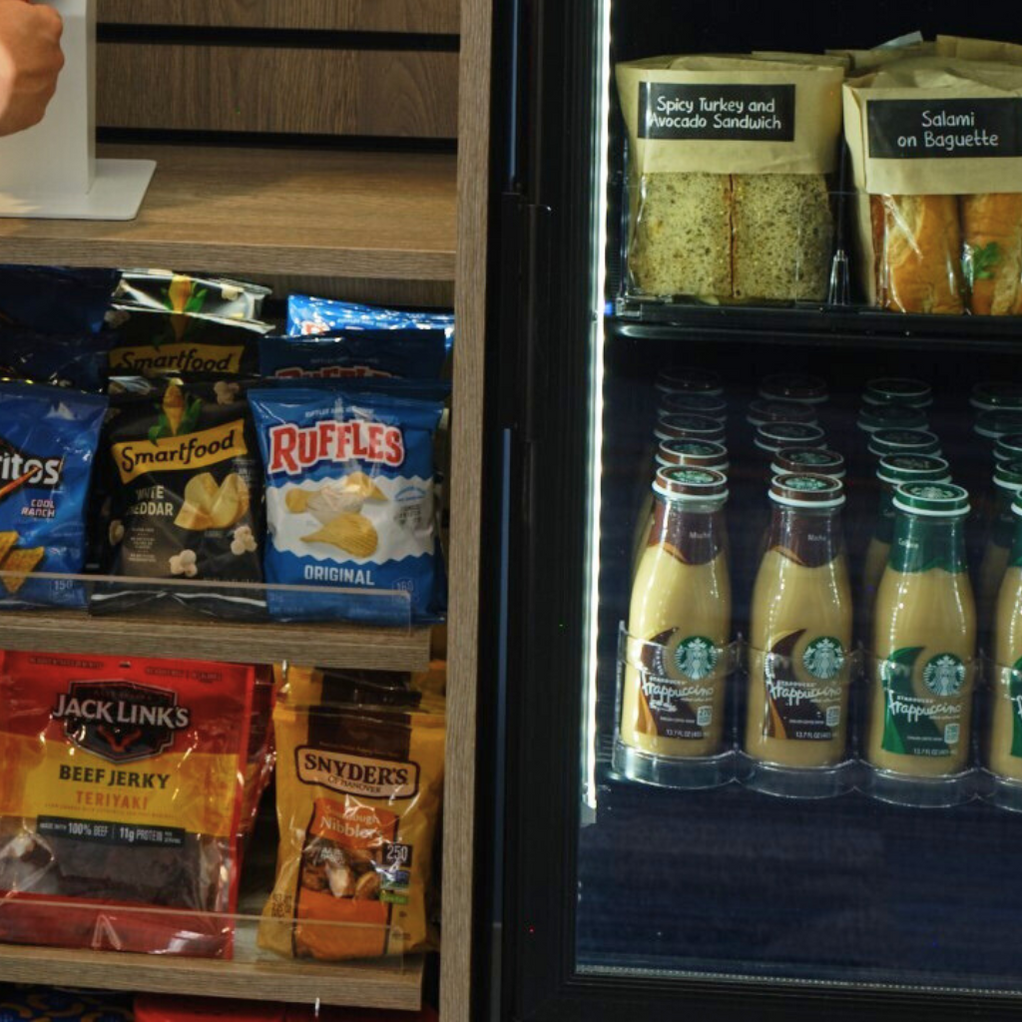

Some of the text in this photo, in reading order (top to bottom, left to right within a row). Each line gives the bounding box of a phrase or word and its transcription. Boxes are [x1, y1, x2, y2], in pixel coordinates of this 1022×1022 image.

[657, 96, 775, 115] Spicy Turkey and
[649, 112, 782, 130] Avocado Sandwich
[922, 110, 975, 127] Salami
[897, 129, 999, 151] on Baguette
[122, 430, 235, 473] Smartfood
[269, 421, 404, 473] RUFFLES
[21, 507, 56, 518] RANCH
[30, 498, 55, 509] COOL
[132, 501, 174, 516] EDDAR
[304, 565, 375, 586] ORIGINAL
[53, 695, 189, 728] JACK LINK'S
[59, 764, 170, 789] BEEF JERKY
[304, 753, 409, 786] SNYDER'S
[76, 790, 148, 810] TERIYAKI
[69, 822, 92, 836] 100%
[93, 824, 108, 837] BEEF
[120, 826, 163, 843] 11g PROTEIN
[386, 845, 408, 861] 250
